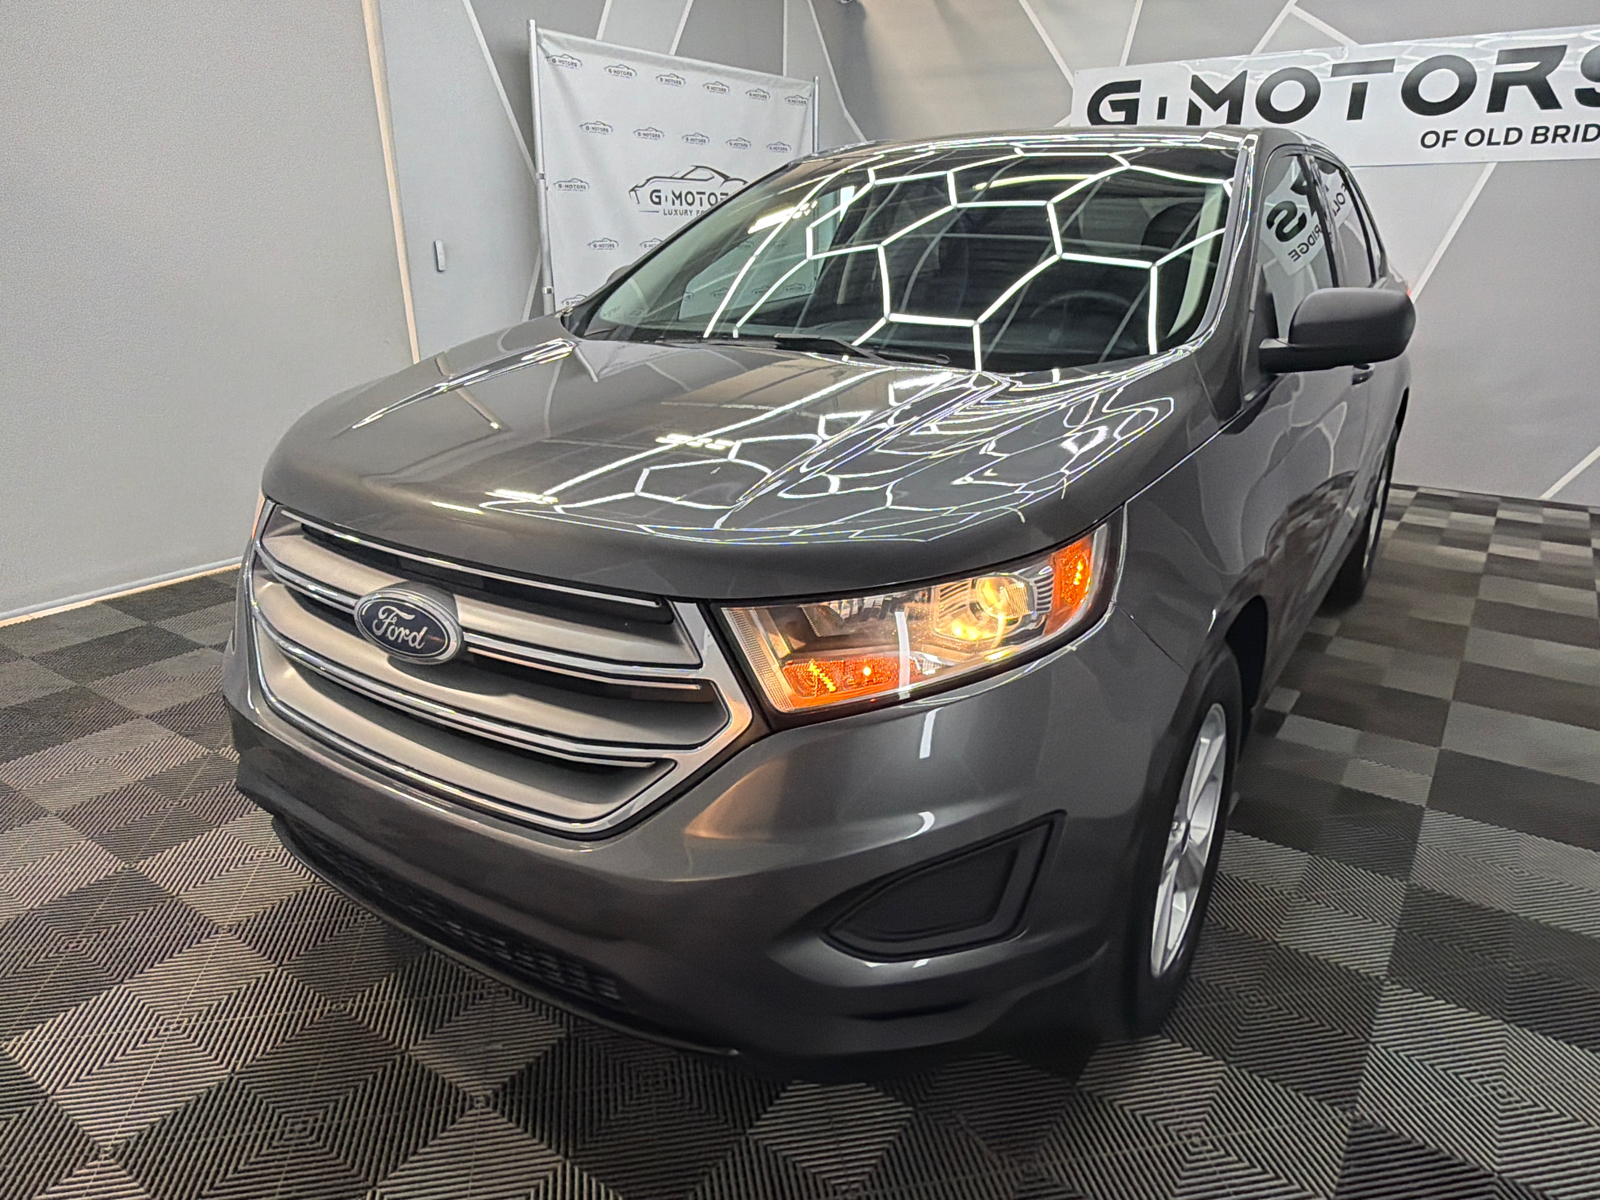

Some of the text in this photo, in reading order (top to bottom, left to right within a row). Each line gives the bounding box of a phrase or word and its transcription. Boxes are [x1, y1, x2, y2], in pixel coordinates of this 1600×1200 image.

[1420, 130, 1458, 148] OF
[1464, 127, 1523, 147] OLD
[663, 208, 693, 217] LUXURY
[372, 605, 428, 649] Ford
